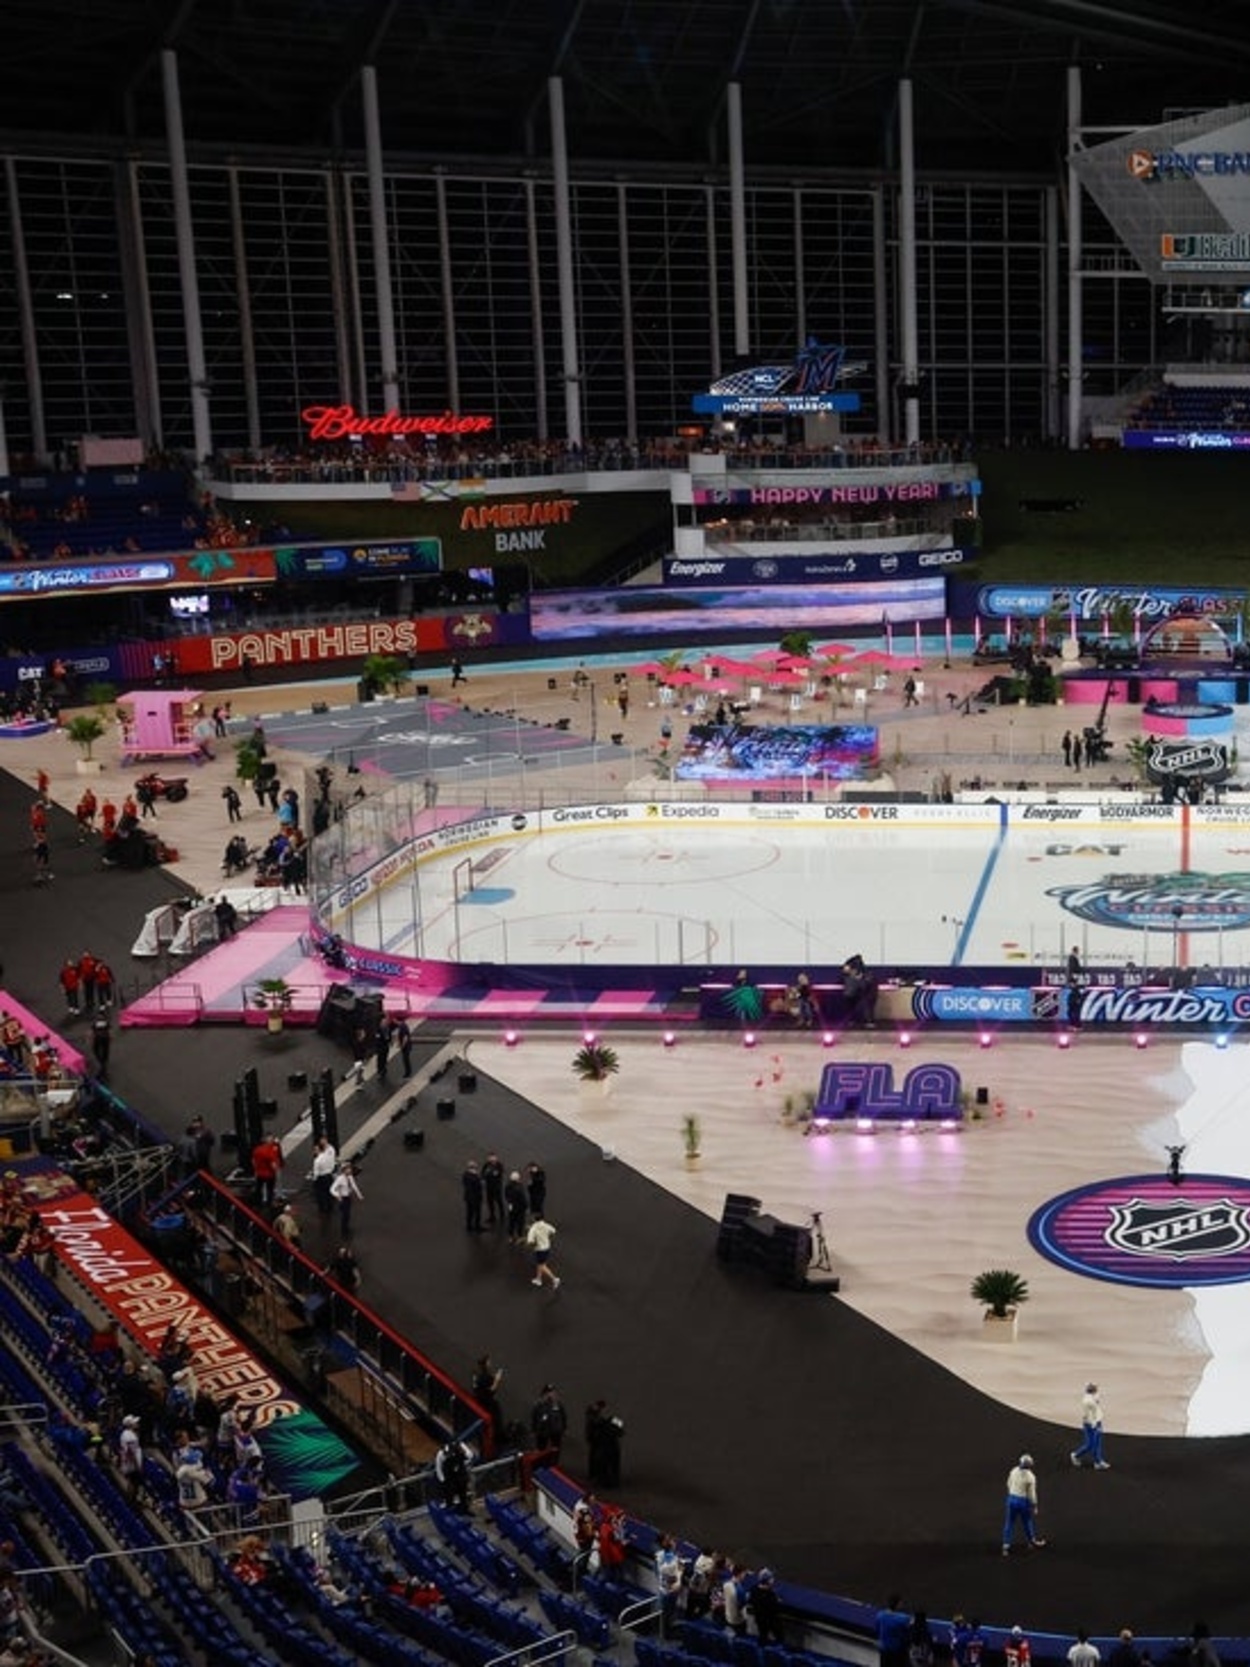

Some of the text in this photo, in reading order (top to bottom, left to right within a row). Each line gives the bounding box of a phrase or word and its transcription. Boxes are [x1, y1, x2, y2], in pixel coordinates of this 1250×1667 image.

[755, 375, 773, 383] NCL
[723, 403, 757, 412] HOME
[788, 403, 833, 411] HARBOR
[302, 404, 492, 439] Budweiser
[752, 487, 939, 503] HAPPY NEW YEAR!
[495, 530, 546, 551] BANK
[919, 550, 963, 566] GEICO
[670, 561, 725, 576] Energizer
[995, 597, 1046, 607] DISCOVER
[211, 621, 418, 669] PANTHERS
[17, 667, 44, 681] CAT
[1167, 745, 1211, 768] NHL
[553, 804, 629, 822] Great Clips
[661, 804, 720, 818] Expedia
[825, 805, 899, 820] DISCOVER
[1023, 806, 1082, 821] Energizer
[1046, 844, 1125, 856] CAT
[943, 998, 1022, 1012] DISCOVER
[1080, 990, 1226, 1022] Winter
[825, 1068, 959, 1108] FLA
[1141, 1213, 1225, 1244] NHL
[40, 1207, 151, 1283] Florida
